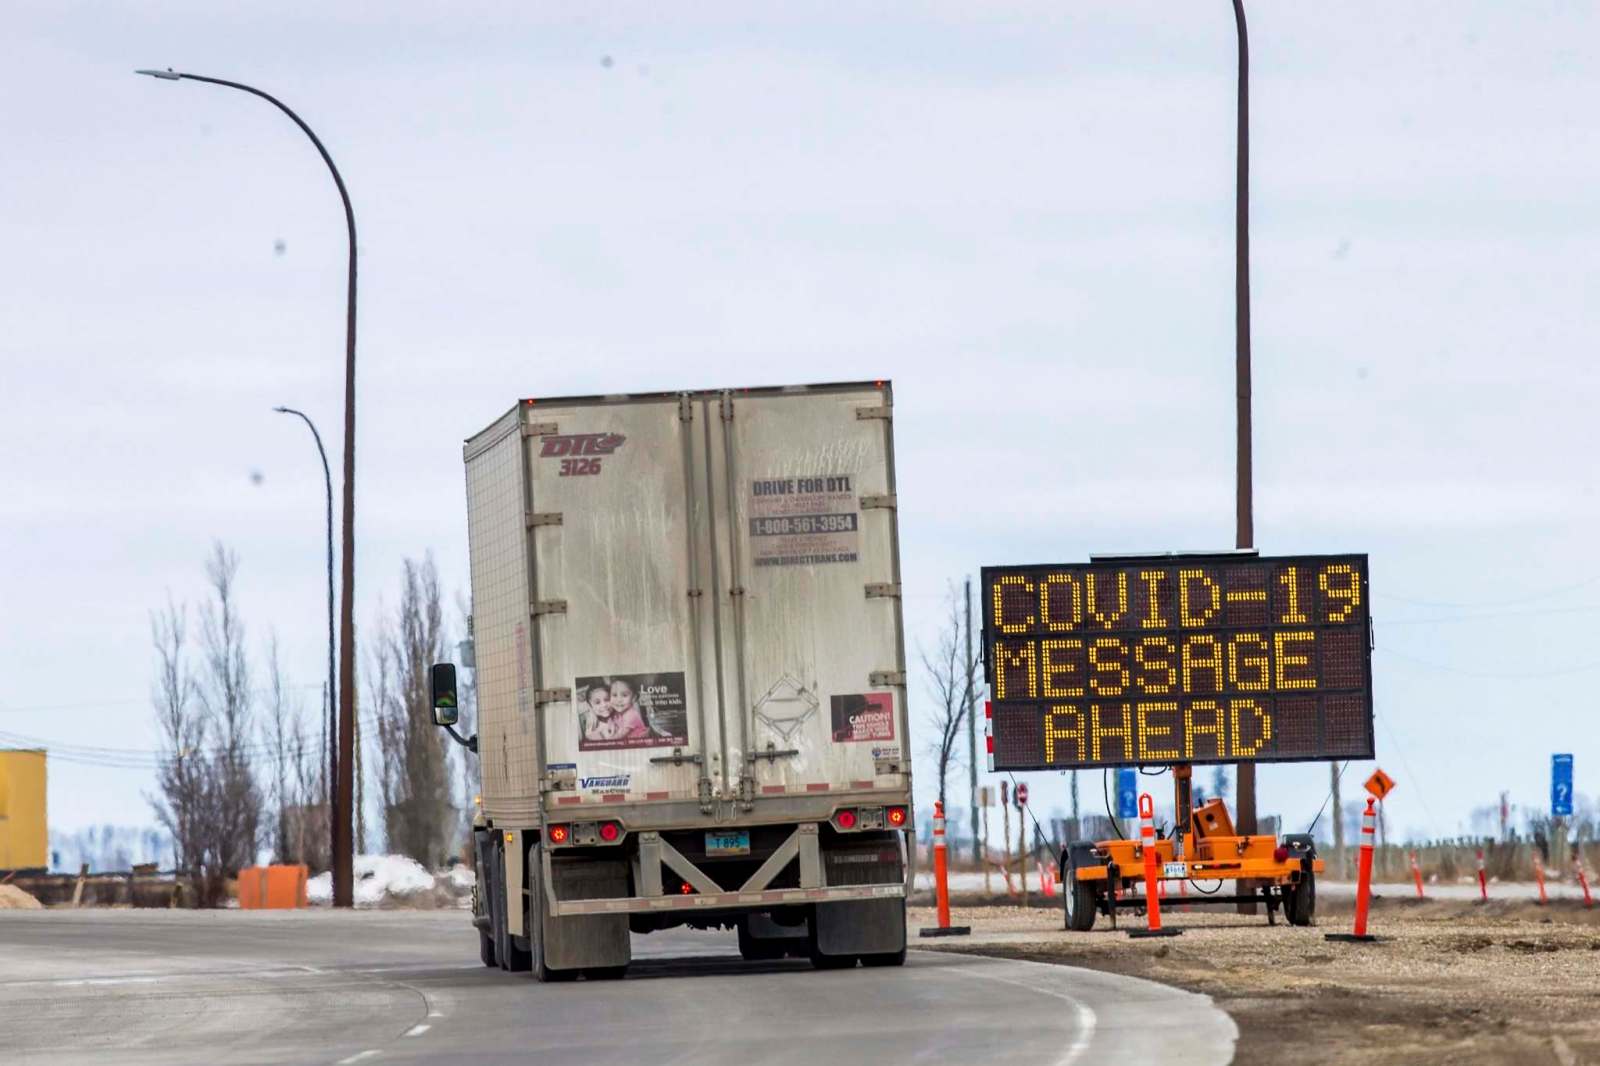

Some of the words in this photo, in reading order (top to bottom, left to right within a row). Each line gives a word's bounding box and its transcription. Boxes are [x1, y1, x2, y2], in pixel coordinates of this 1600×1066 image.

[540, 433, 620, 457] DTL
[559, 457, 603, 477] 3126
[752, 480, 794, 496] DRIVE
[797, 478, 823, 494] FOR
[827, 476, 852, 492] DTL
[755, 515, 853, 534] 1-800-561-3954
[992, 563, 1361, 634] COVID-19
[994, 630, 1318, 700] MESSAGE
[640, 684, 668, 694] Love
[849, 711, 891, 725] CAUTION!
[1044, 698, 1272, 763] AHEAD
